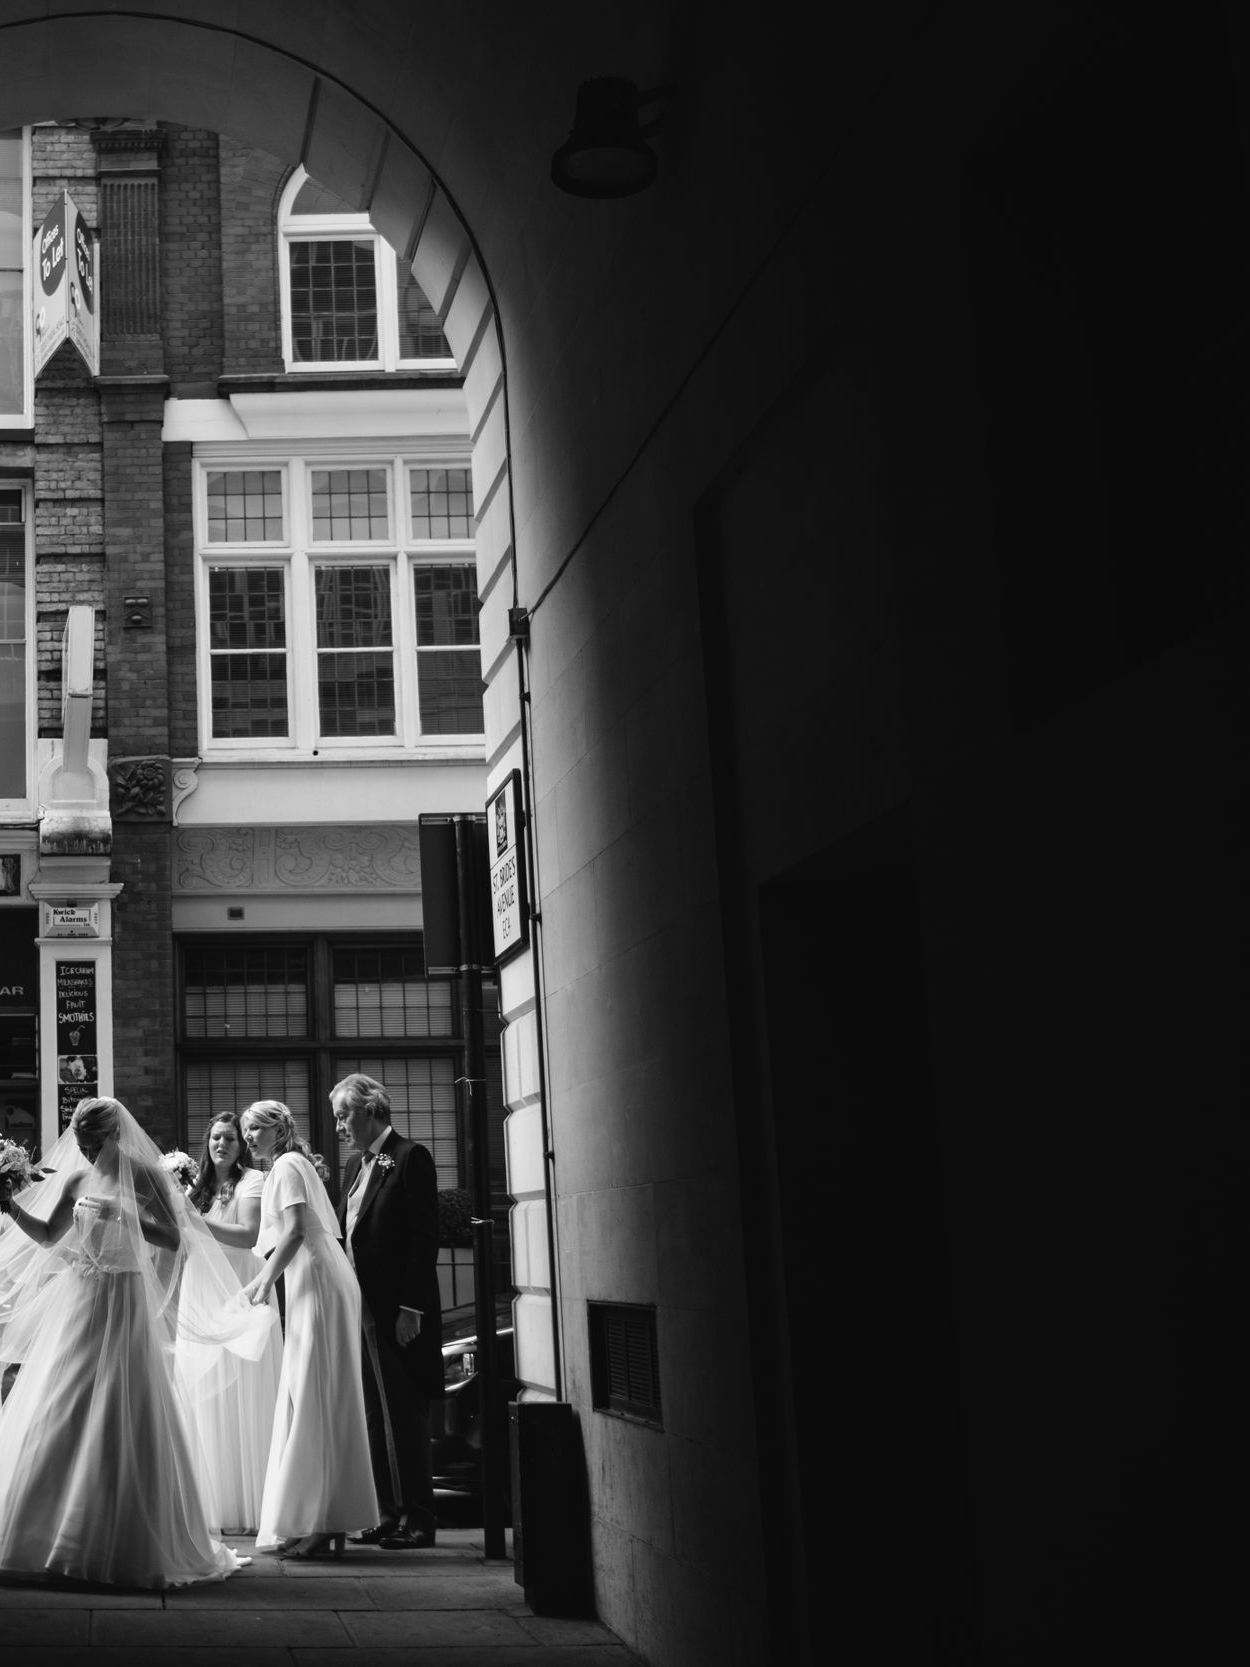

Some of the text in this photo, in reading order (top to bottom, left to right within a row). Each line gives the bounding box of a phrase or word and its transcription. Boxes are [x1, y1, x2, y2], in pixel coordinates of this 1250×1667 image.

[42, 236, 64, 280] To Let
[77, 248, 85, 277] To
[497, 884, 515, 918] AVENUE
